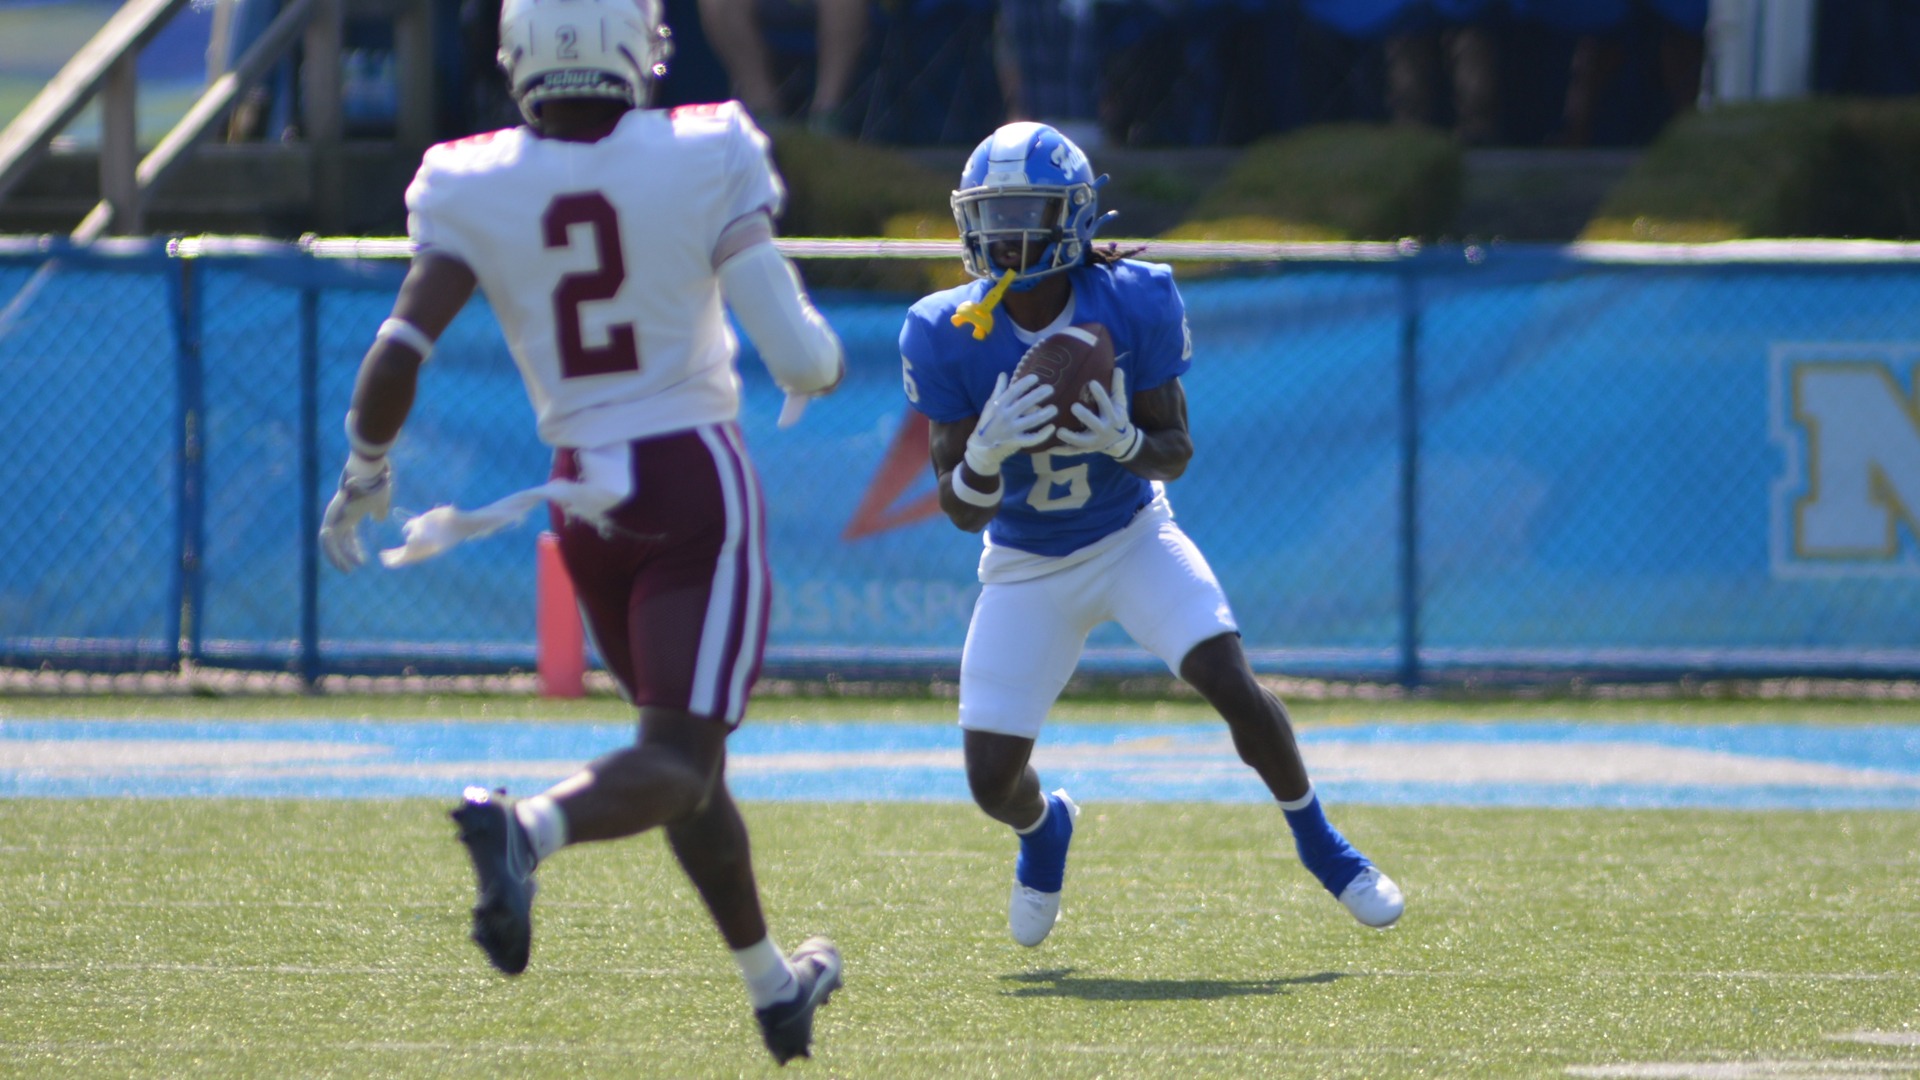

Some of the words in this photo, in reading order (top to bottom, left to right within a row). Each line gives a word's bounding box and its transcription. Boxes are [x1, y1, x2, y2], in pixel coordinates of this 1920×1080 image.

[555, 25, 579, 59] 2
[541, 189, 640, 379] 2
[900, 353, 920, 404] 6
[1026, 452, 1092, 512] 6
